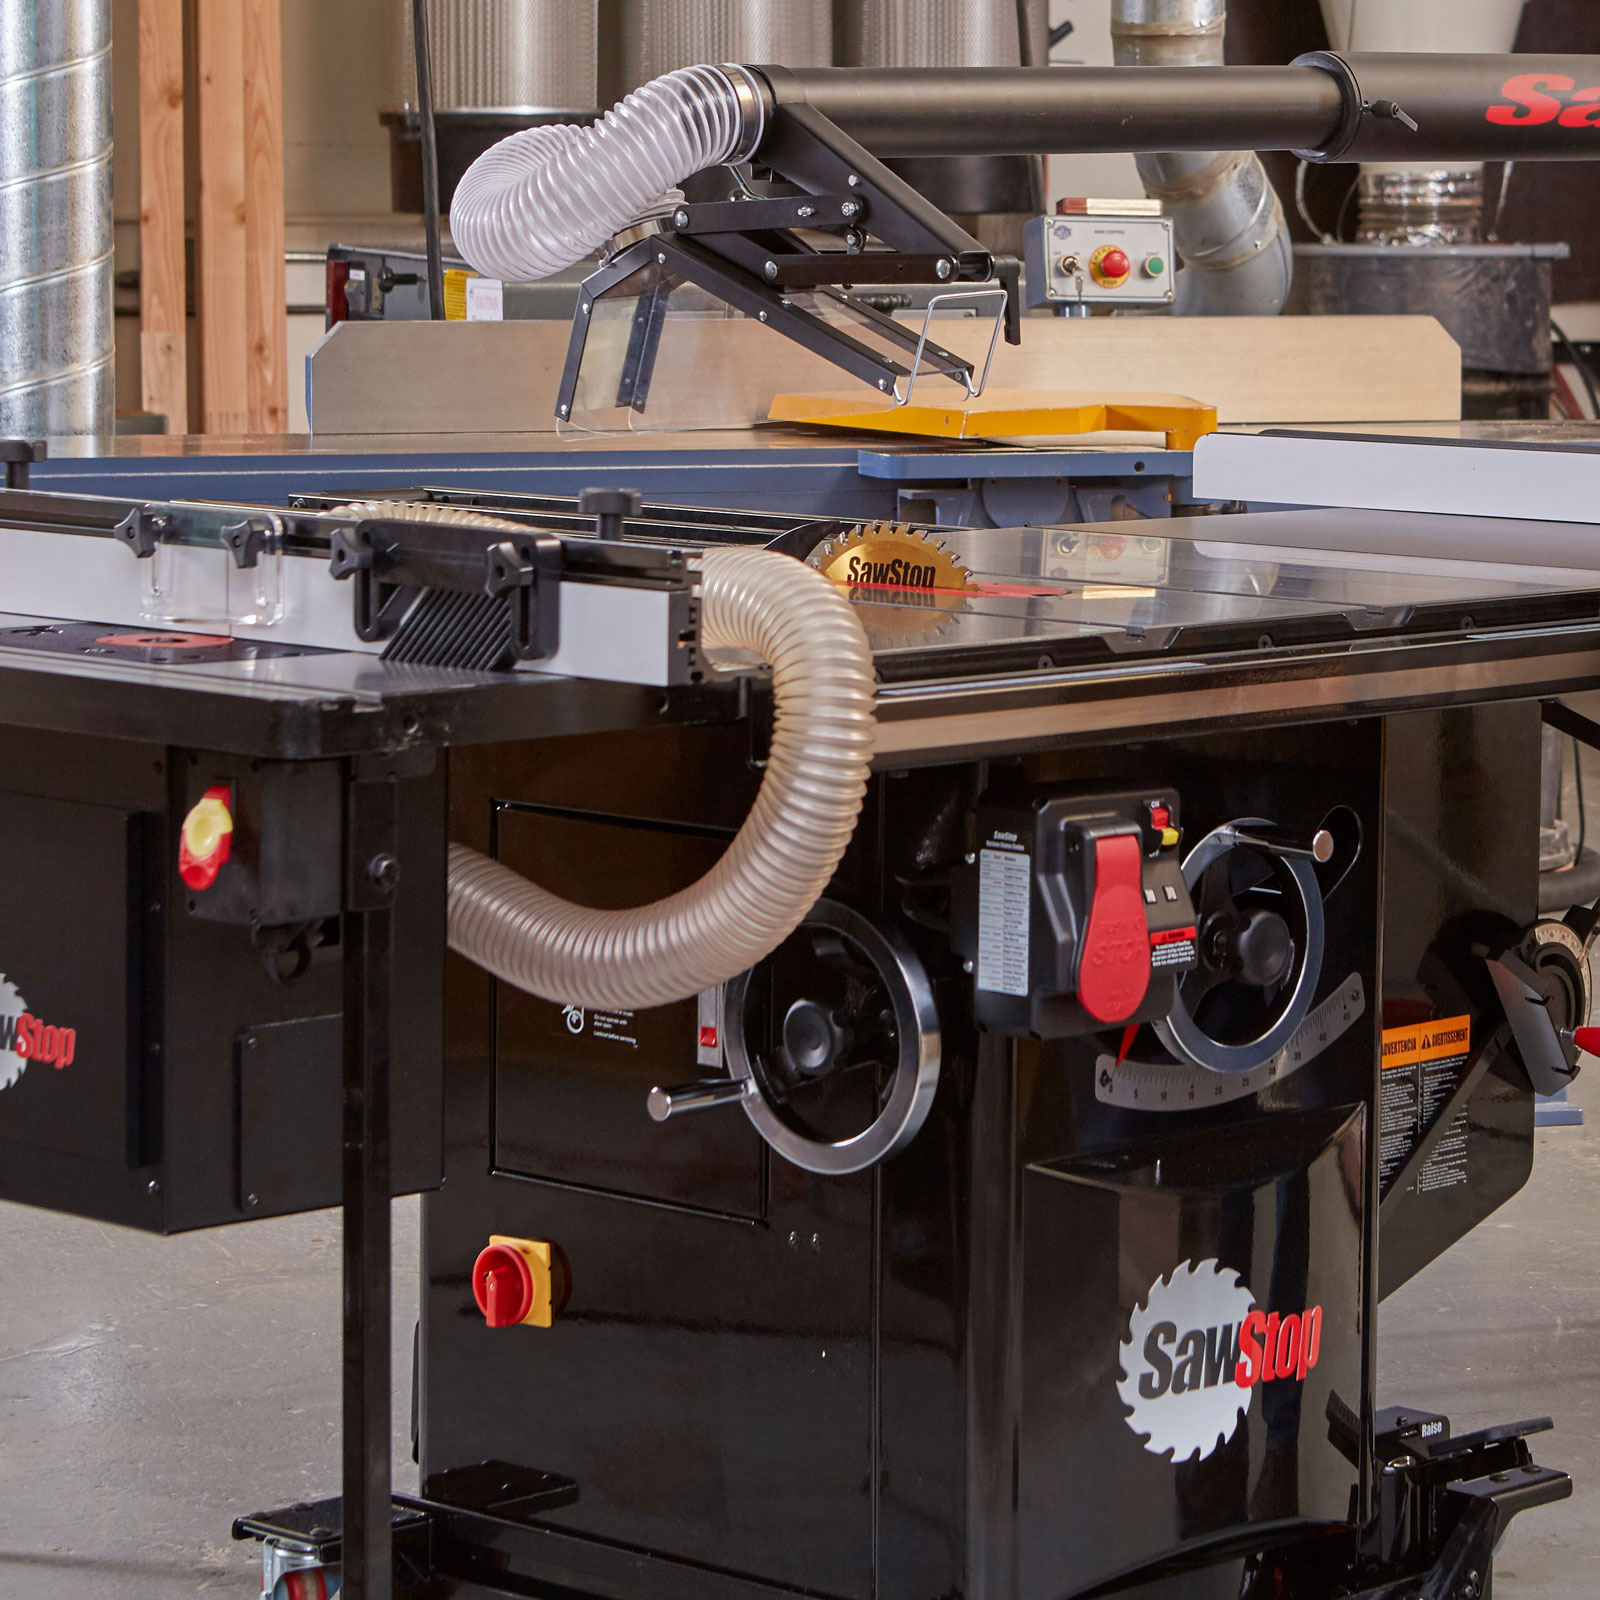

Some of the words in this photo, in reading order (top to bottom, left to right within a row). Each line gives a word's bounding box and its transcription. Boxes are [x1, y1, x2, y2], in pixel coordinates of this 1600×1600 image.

[1382, 1037, 1417, 1056] DVERTENCIA
[1431, 1027, 1468, 1047] AVERTISSEMENT
[1138, 1304, 1323, 1400] SawStop
[1421, 1421, 1443, 1438] Raise
